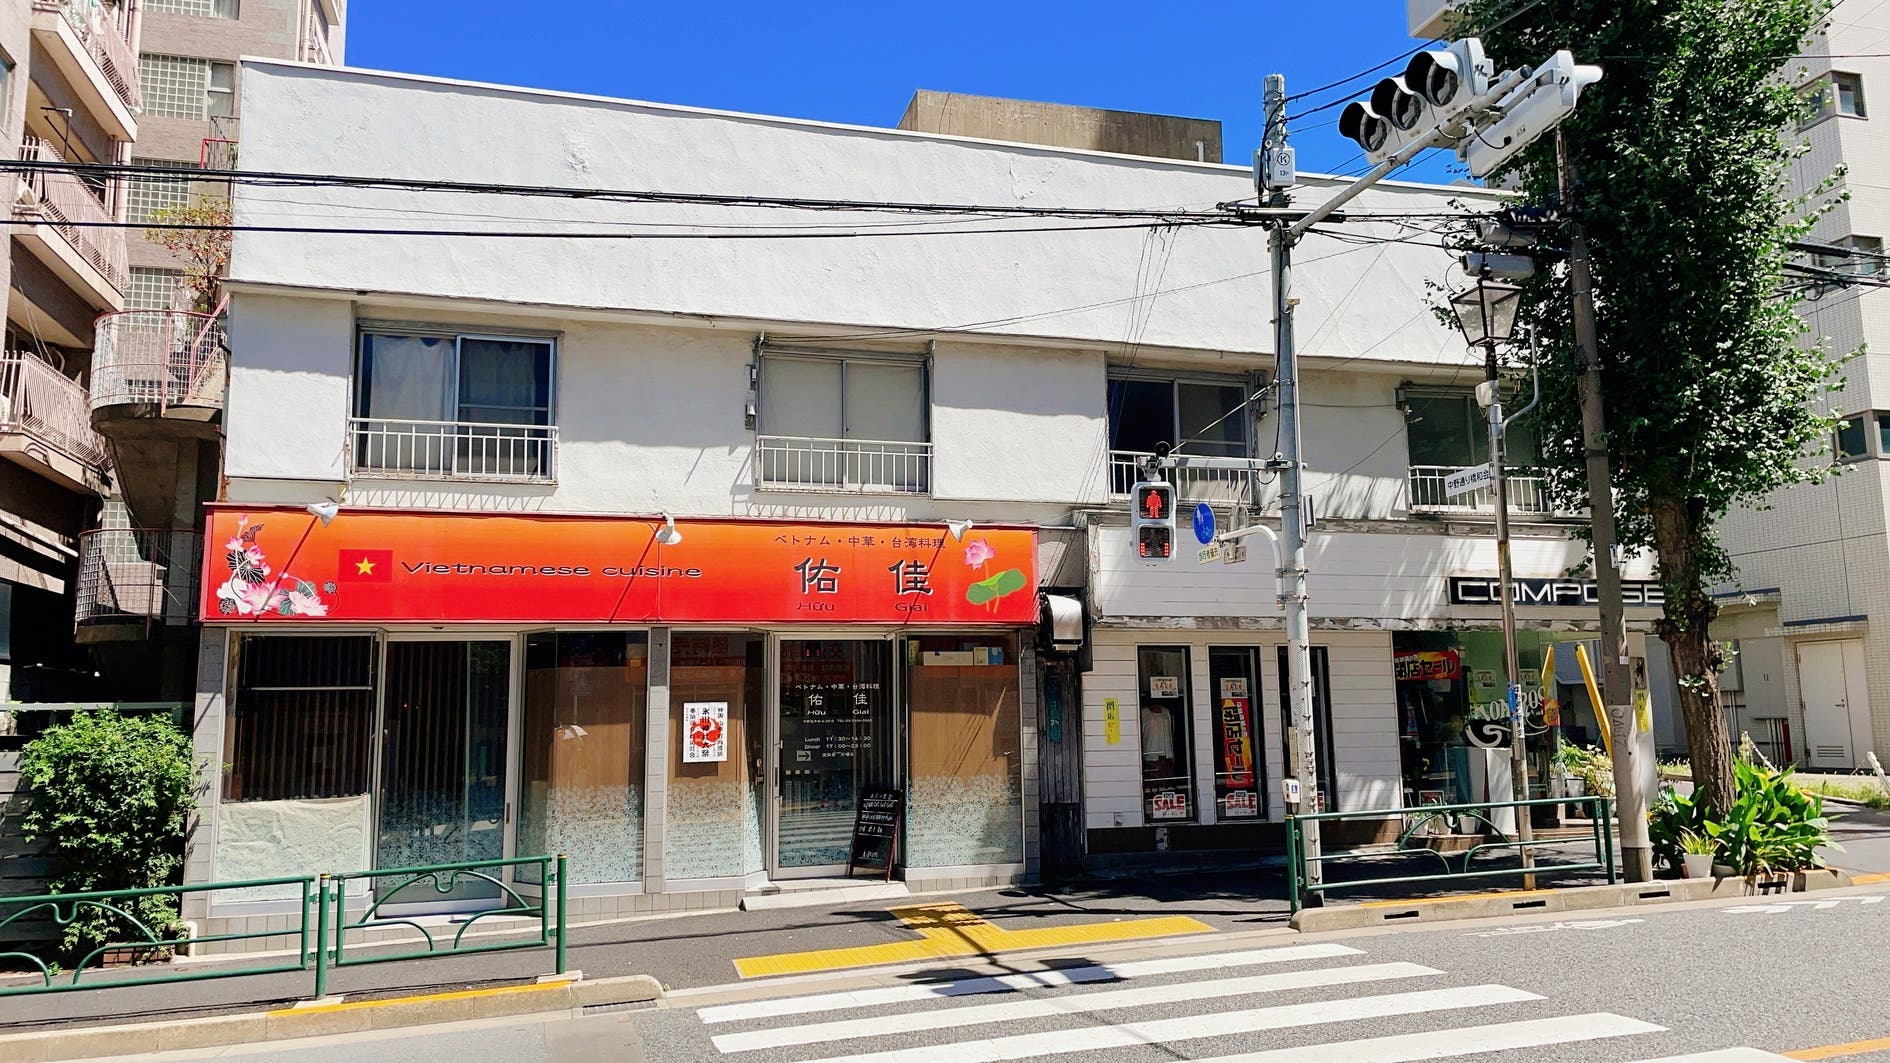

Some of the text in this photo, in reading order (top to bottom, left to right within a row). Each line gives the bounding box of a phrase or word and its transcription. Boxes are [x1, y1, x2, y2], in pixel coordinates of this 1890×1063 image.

[774, 535, 946, 549] ベトナム・中華・台湾料理
[401, 561, 702, 577] Vietnamese cuisine
[794, 557, 933, 595] 佑 佳
[808, 693, 868, 706] 佑 佳
[1154, 795, 1184, 811] SALE
[1226, 795, 1256, 810] SALE
